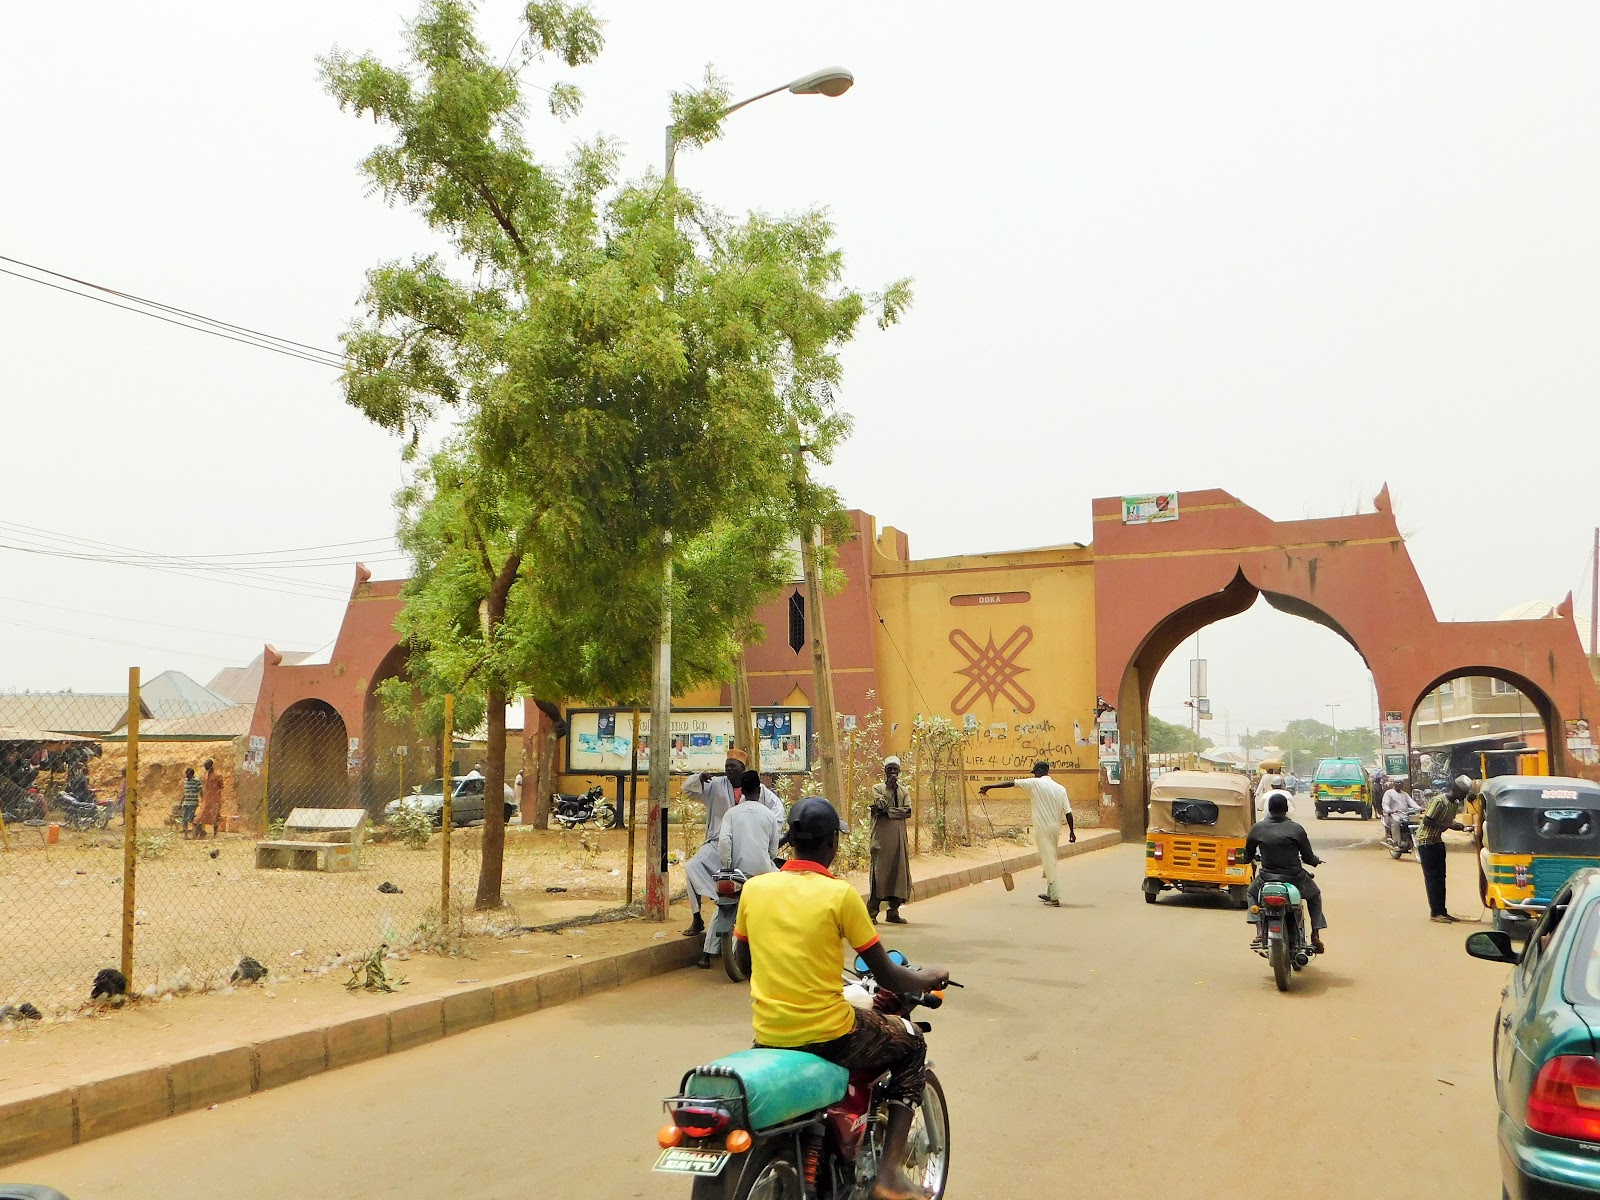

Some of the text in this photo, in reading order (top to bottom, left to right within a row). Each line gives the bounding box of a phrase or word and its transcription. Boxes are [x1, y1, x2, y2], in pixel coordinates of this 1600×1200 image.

[978, 596, 1001, 604] DOKA
[692, 719, 708, 731] to
[1021, 740, 1073, 758] Satan
